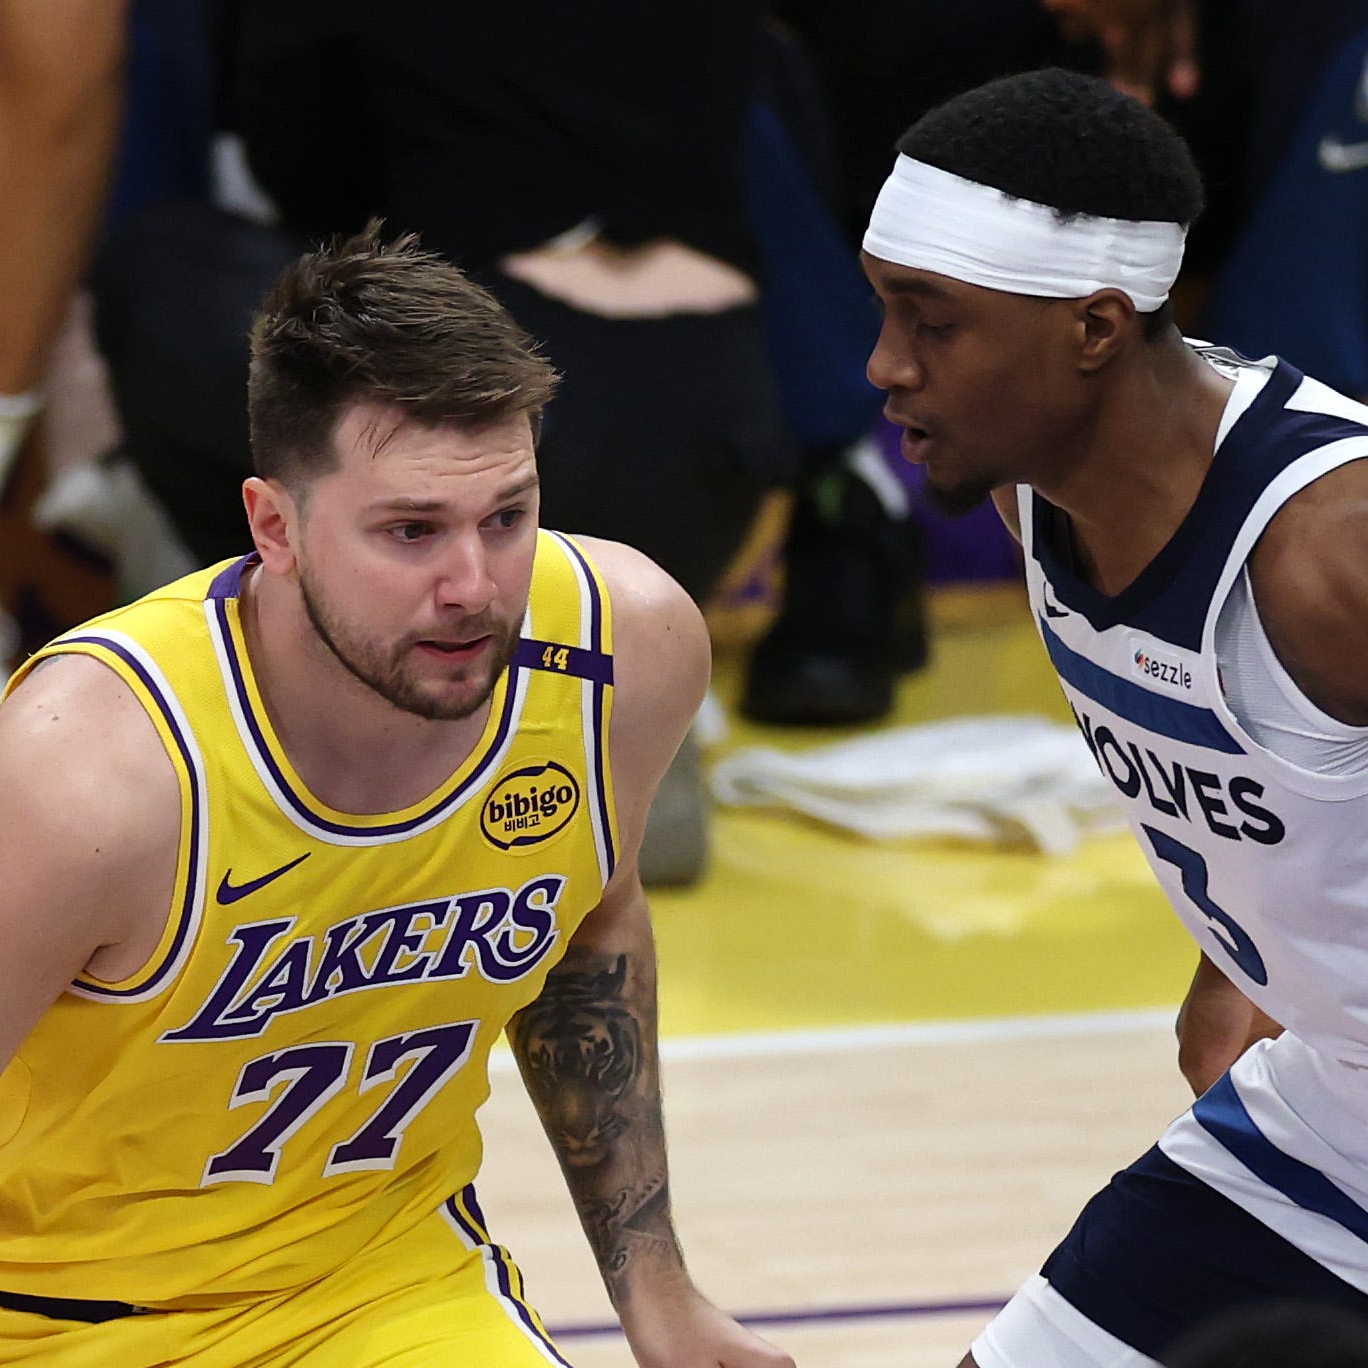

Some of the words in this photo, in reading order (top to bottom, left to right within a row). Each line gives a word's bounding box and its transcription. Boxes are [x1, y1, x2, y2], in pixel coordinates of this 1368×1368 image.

[541, 645, 571, 671] 44
[1144, 656, 1192, 690] sezzle
[489, 784, 573, 824] bibigo
[504, 813, 541, 833] 비비고
[1139, 822, 1269, 987] 3
[156, 874, 568, 1043] LAKERS
[200, 1019, 481, 1188] 77
